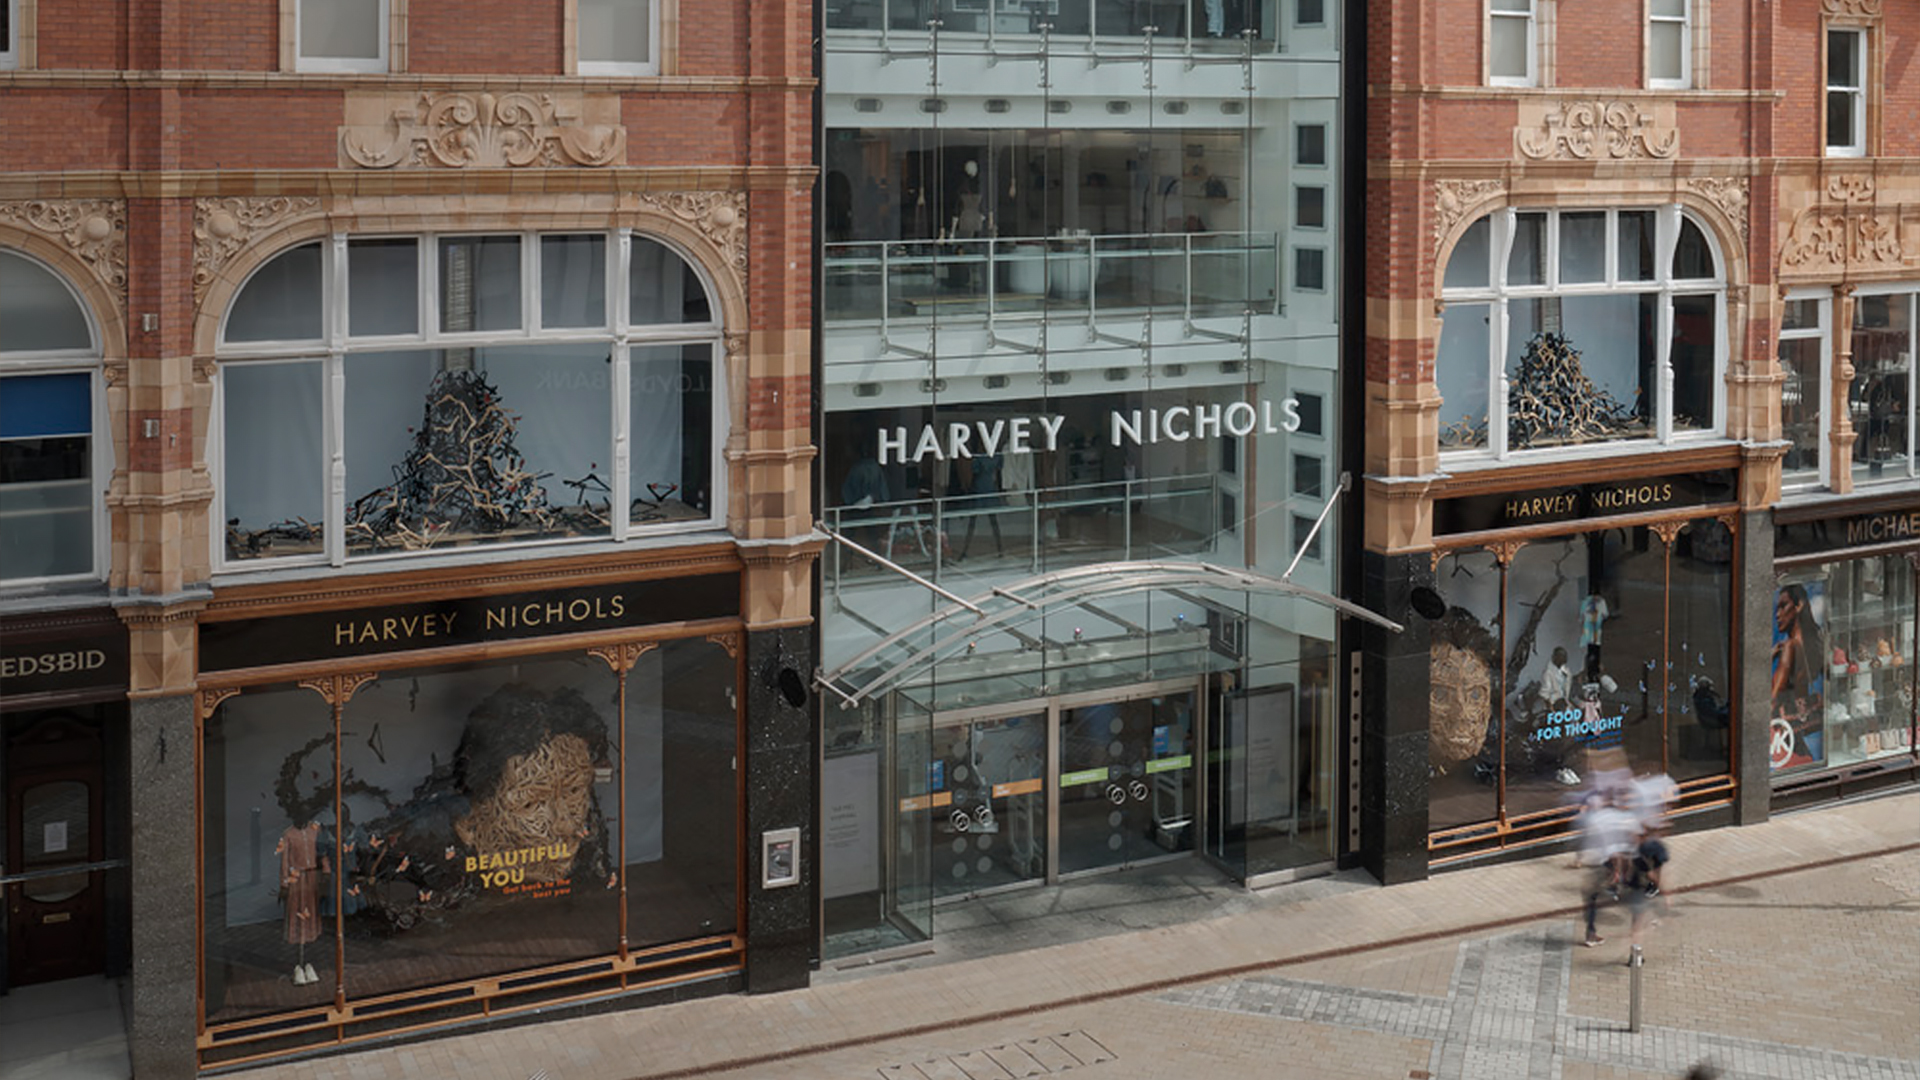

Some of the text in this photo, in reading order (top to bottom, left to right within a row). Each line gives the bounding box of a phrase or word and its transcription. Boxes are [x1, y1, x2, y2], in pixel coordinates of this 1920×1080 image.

[878, 398, 1301, 465] HARVEY NICHOLS
[1505, 484, 1673, 519] HARVEY NICHOLS
[1847, 513, 1920, 544] MICHAE
[335, 595, 625, 645] HARVEY NICHOLS
[0, 649, 106, 678] EDSBID
[1537, 726, 1562, 742] FOR
[1564, 715, 1624, 737] THOUGHT
[1546, 708, 1583, 725] FOOD
[465, 843, 571, 872] BEAUTIFUL
[479, 868, 525, 889] YOU
